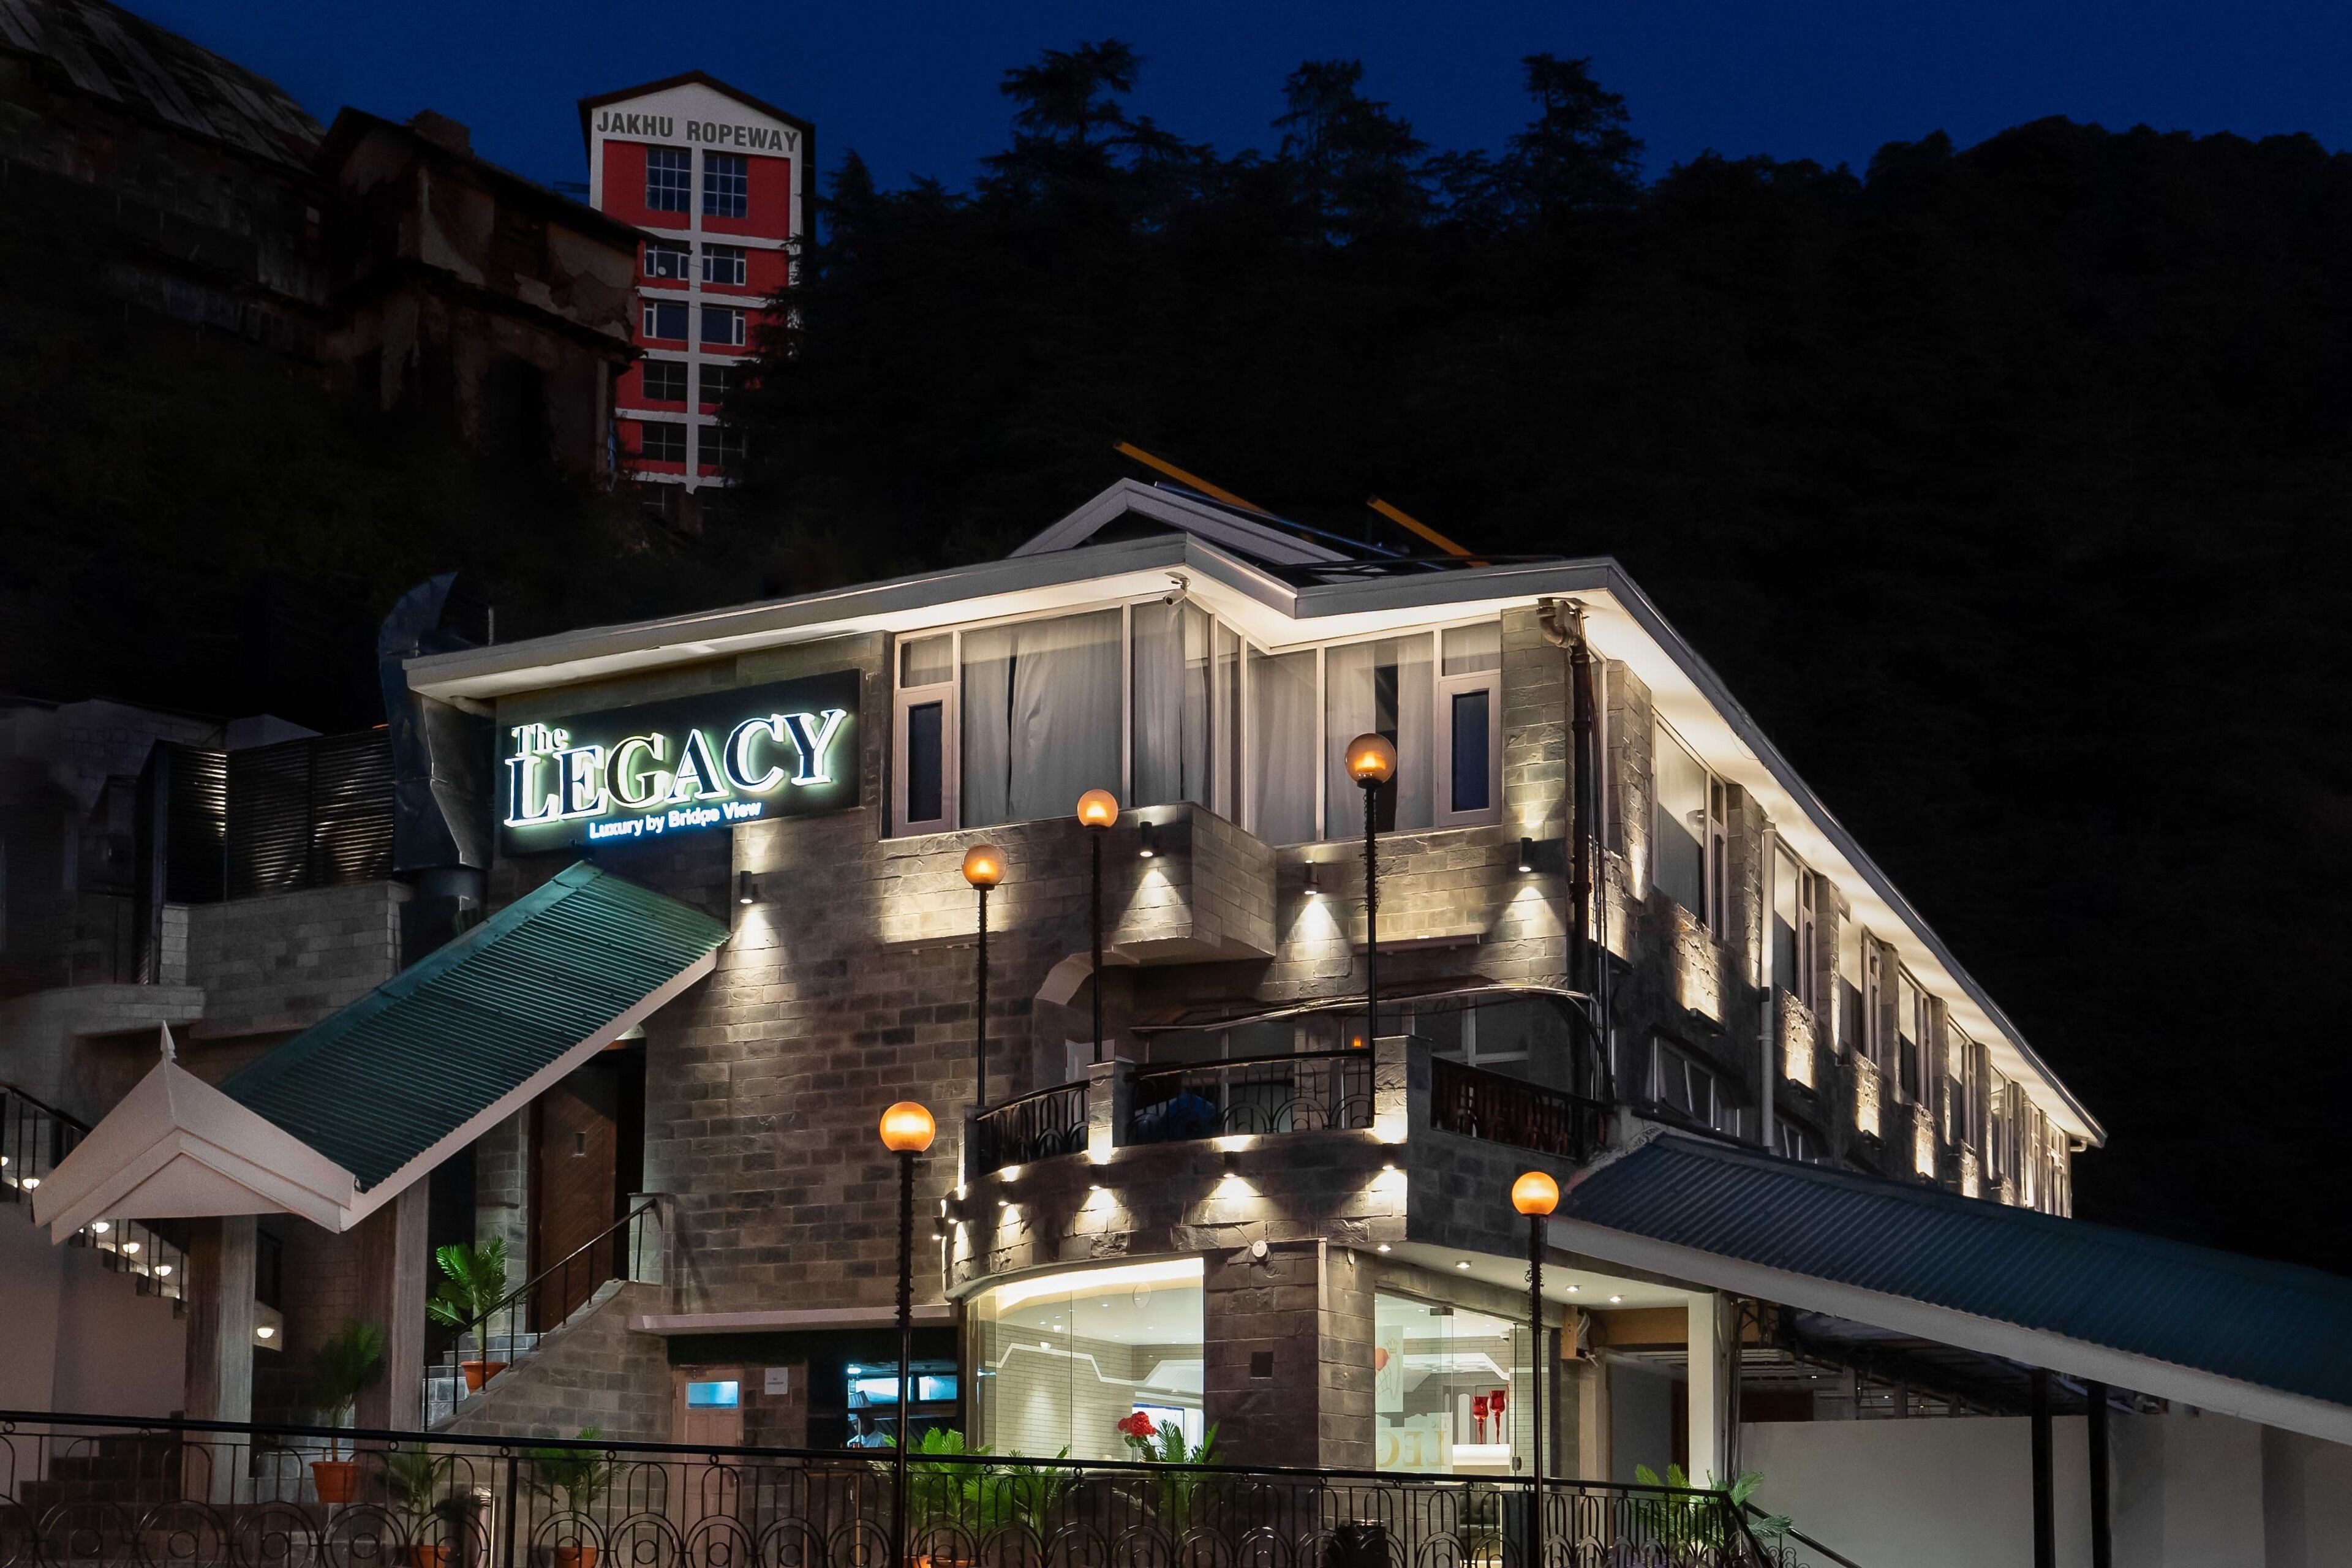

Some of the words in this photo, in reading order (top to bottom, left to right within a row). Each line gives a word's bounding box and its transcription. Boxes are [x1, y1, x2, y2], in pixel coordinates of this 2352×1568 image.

[597, 111, 673, 137] JAKHU
[687, 120, 799, 151] ROPEWAY
[511, 723, 568, 757] The
[503, 709, 847, 827] LEGACY
[589, 820, 644, 839] Luxury
[646, 814, 665, 833] by
[668, 807, 720, 827] Bridge
[722, 801, 761, 820] View
